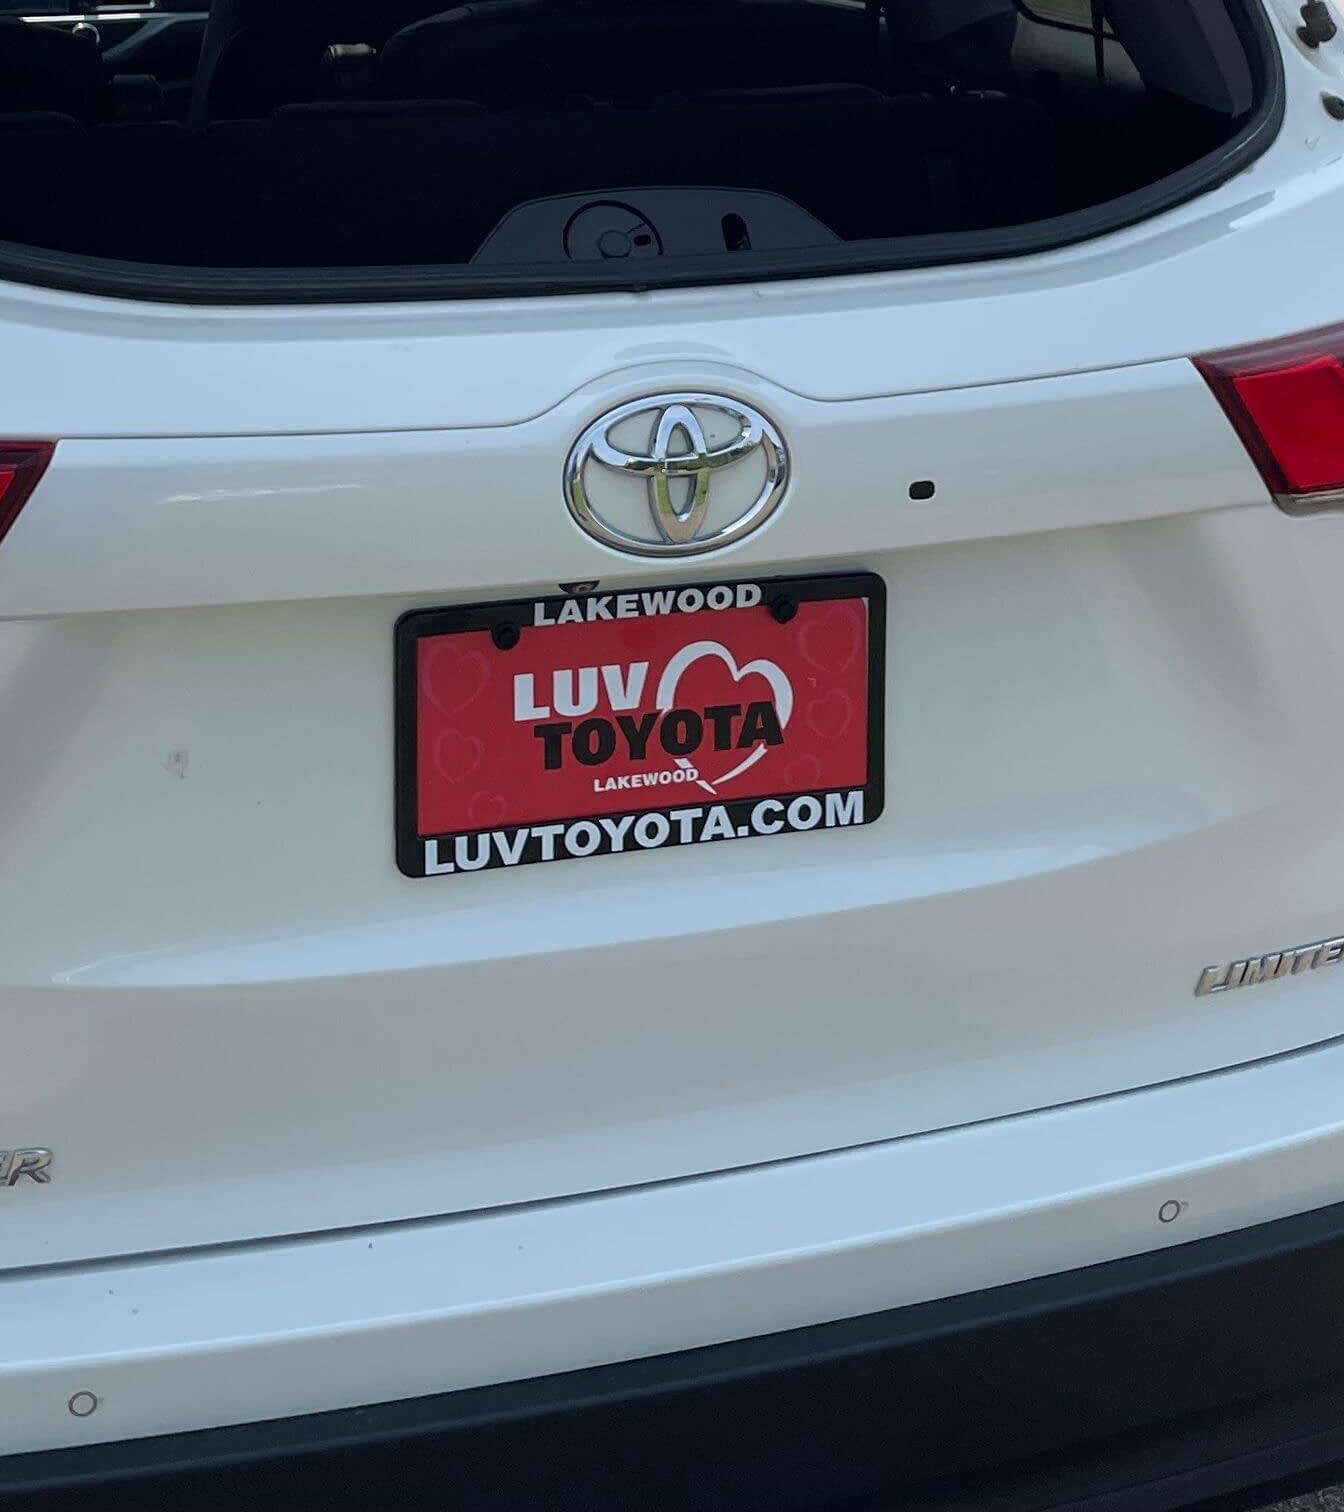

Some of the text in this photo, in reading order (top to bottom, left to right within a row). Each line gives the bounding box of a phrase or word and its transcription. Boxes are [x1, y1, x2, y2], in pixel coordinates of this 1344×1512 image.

[533, 583, 762, 627] LAKEWOOD
[513, 662, 649, 721] LUV
[534, 701, 785, 770] TOYOTA
[593, 767, 699, 792] LAKEWOOD
[424, 791, 864, 876] LUVTOYOTA.COM
